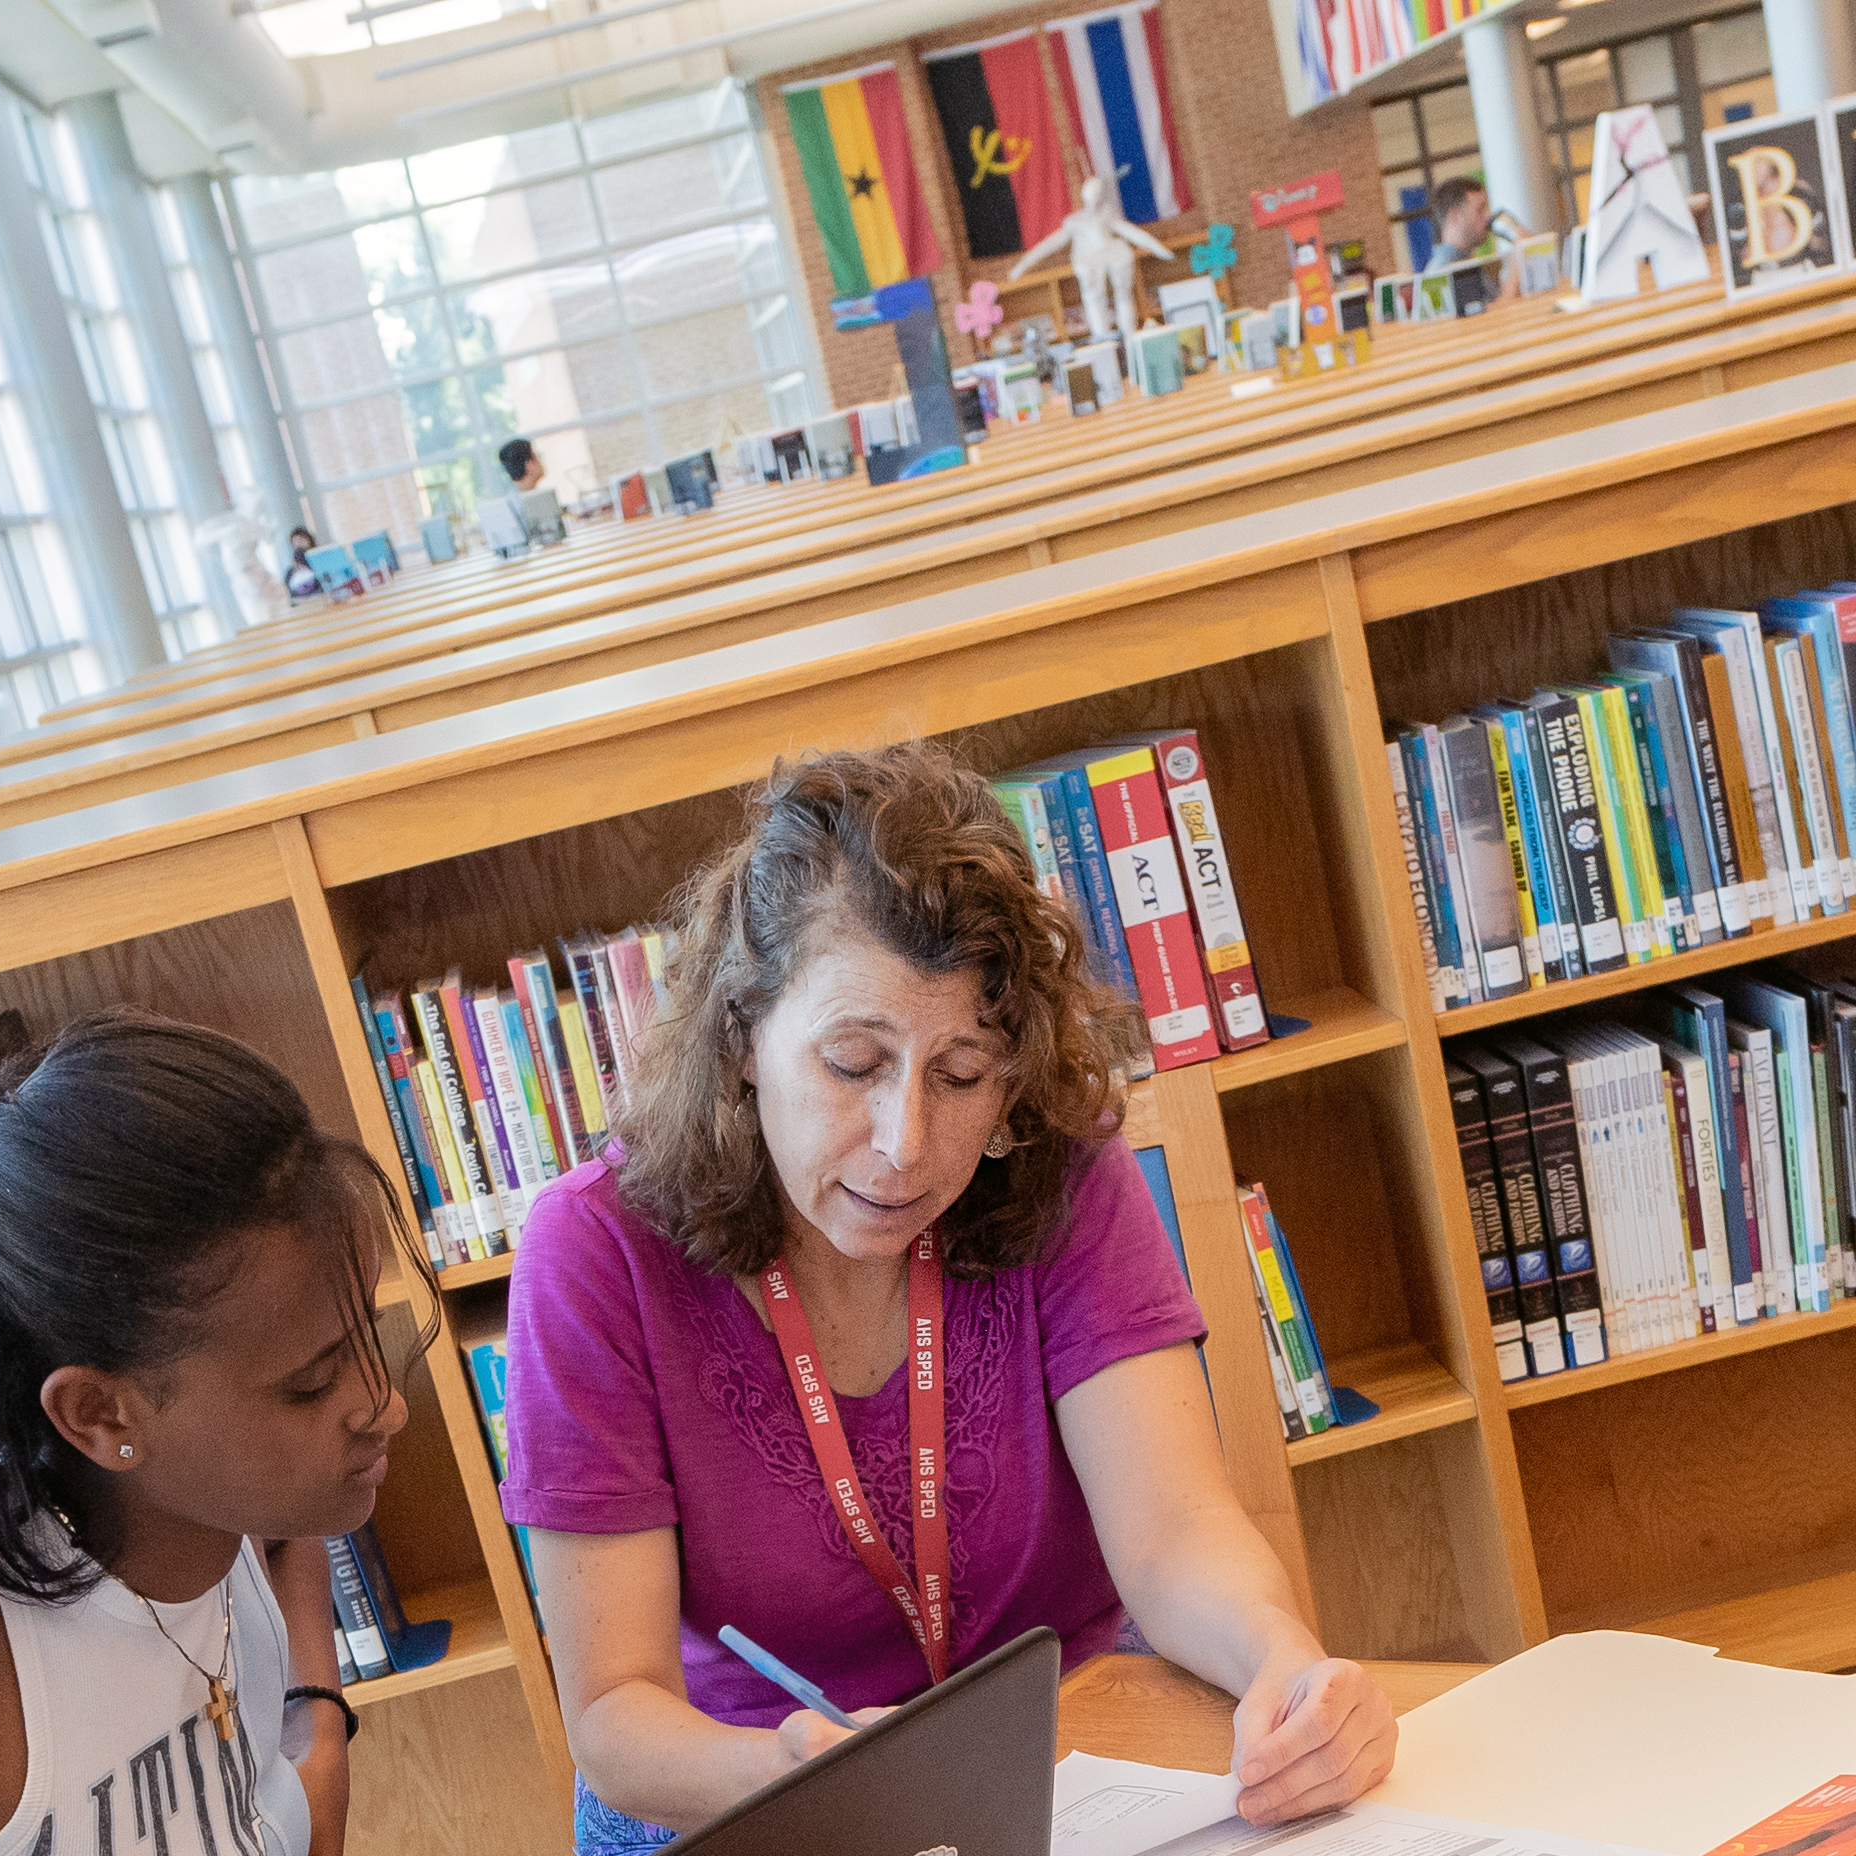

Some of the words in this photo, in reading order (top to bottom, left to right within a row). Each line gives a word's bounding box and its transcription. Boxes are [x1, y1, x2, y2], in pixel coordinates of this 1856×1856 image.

[1544, 717, 1567, 751] THE
[1695, 718, 1710, 742] THE
[1562, 713, 1595, 808] EXPLODING
[1700, 744, 1716, 774] WEST
[1117, 781, 1130, 801] THE
[1496, 769, 1511, 794] FAIR
[1552, 754, 1578, 813] PHONE
[1706, 776, 1721, 800] THE
[1121, 800, 1141, 843] OFFICIAL
[1176, 796, 1216, 845] Real
[1501, 795, 1516, 828] TRADE
[1076, 821, 1098, 855] SAT
[1515, 768, 1533, 825] SHACKLES
[1536, 882, 1549, 911] DEEP
[1711, 800, 1733, 862] RAILROADS
[1052, 833, 1073, 867] SAT
[1086, 856, 1108, 905] CRITICAL
[1129, 851, 1161, 914] ACT
[1191, 843, 1223, 892] ACT
[1583, 854, 1599, 884] PHIL
[1098, 906, 1120, 956] READING
[1149, 920, 1163, 945] PREP
[1155, 945, 1171, 975] GUIDE
[423, 1003, 442, 1032] The
[480, 1008, 504, 1054] GLIMMER
[431, 1030, 450, 1059] End
[374, 1059, 394, 1099] SCHOOLS
[438, 1058, 455, 1077] of
[492, 1054, 508, 1070] OF
[496, 1069, 515, 1097] HOPE
[386, 1097, 397, 1111] IN
[442, 1075, 469, 1128] College
[487, 1096, 502, 1127] SCHOOLS
[389, 1110, 410, 1156] COLONIAL
[509, 1120, 530, 1150] MARCH
[530, 1111, 556, 1163] PARKLAND
[1695, 1118, 1716, 1182] FORTIES
[461, 1141, 484, 1180] Kevin
[484, 1141, 506, 1186] TOMORROW
[517, 1148, 534, 1167] FOR
[522, 1164, 539, 1185] OUR
[401, 1155, 421, 1196] AMERICA
[1545, 1167, 1560, 1191] AND
[1516, 1172, 1544, 1244] CLOTHING
[1548, 1191, 1569, 1237] FASHION
[1558, 1162, 1586, 1234] CLOTHING
[766, 1270, 789, 1300] AHS
[915, 1317, 933, 1348] AHS
[795, 1354, 821, 1395] SPED
[917, 1350, 933, 1390] SPED
[808, 1395, 830, 1424] AHS
[918, 1447, 935, 1477] AHS
[835, 1478, 861, 1519] SPED
[919, 1479, 936, 1519] SPED
[845, 1516, 875, 1544] AHS
[892, 1585, 918, 1617] SPED
[925, 1573, 940, 1602] AHS
[926, 1603, 943, 1641] SPED
